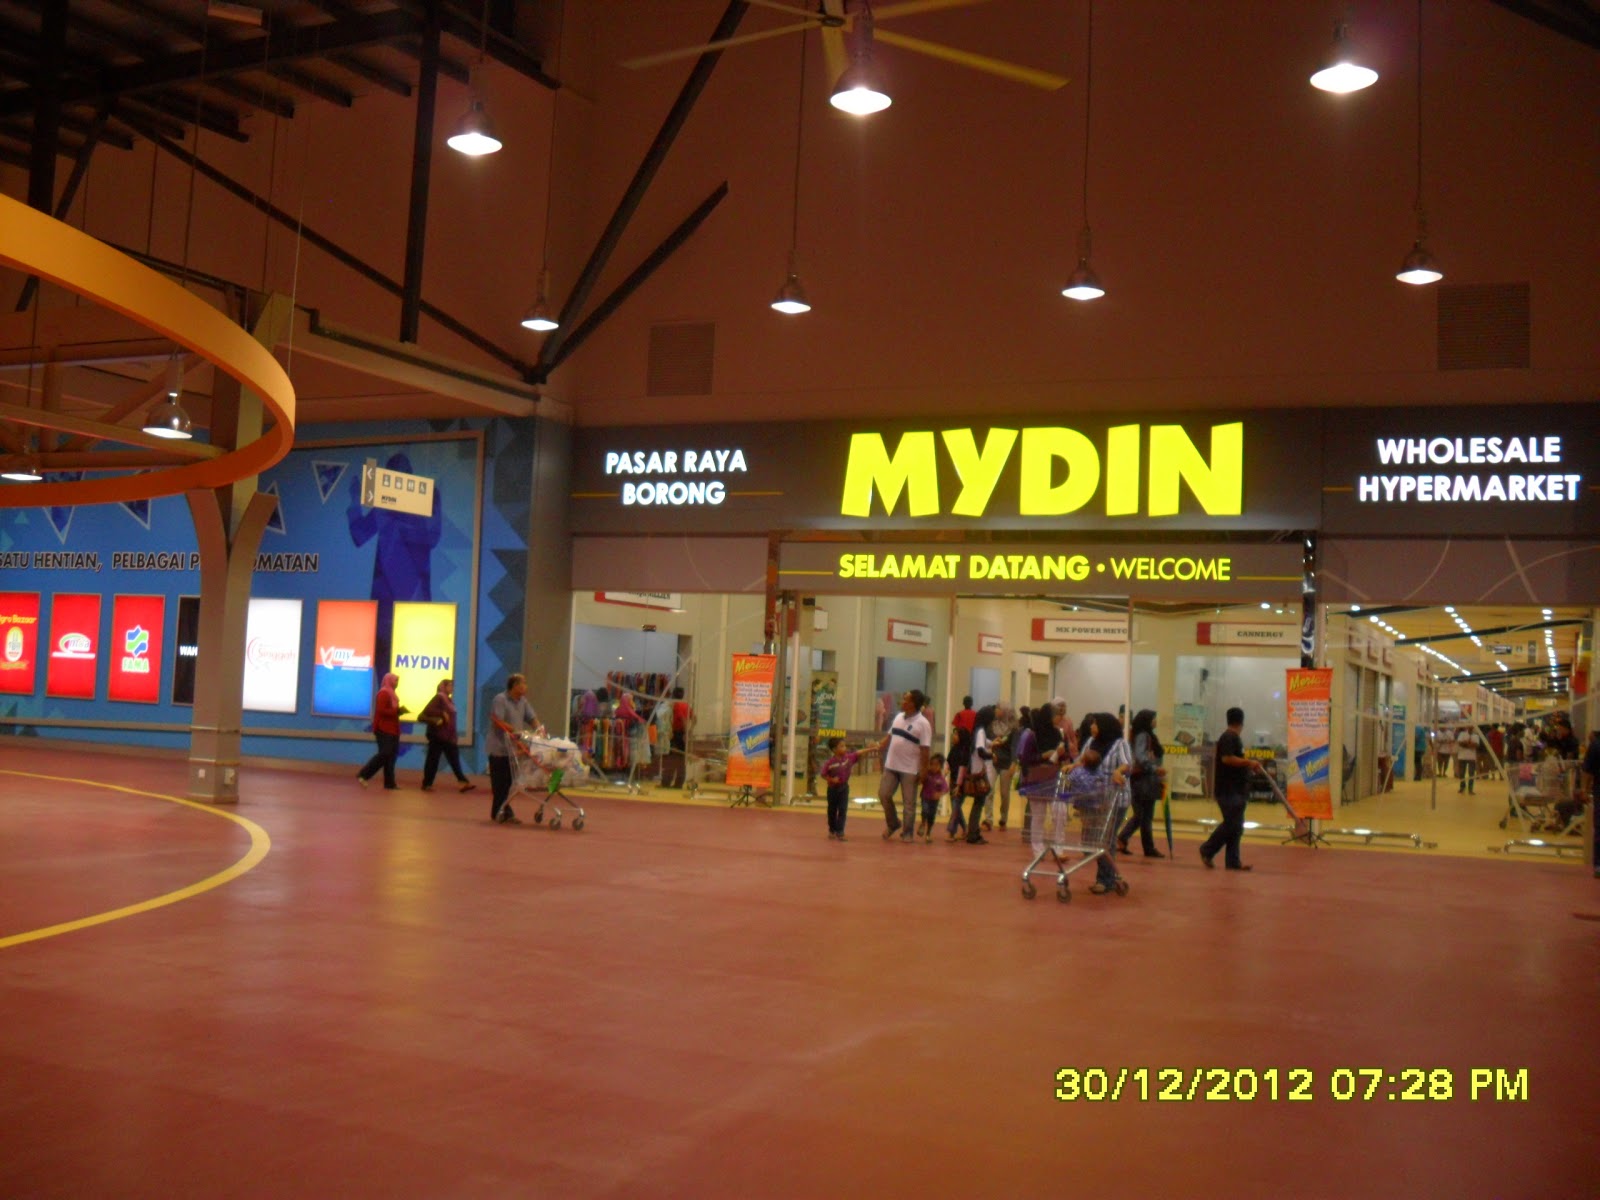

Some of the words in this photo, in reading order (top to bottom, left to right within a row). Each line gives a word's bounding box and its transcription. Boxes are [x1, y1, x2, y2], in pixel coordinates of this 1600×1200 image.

[605, 451, 677, 474] PASAR
[684, 449, 747, 472] RAYA
[1377, 437, 1561, 464] WHOLESALE
[841, 422, 1243, 517] MYDIN
[622, 482, 726, 505] BORONG
[1359, 475, 1581, 502] HYPERMARKET
[33, 551, 102, 572] HENTIAN,
[112, 552, 185, 570] PELBAGAI
[838, 554, 960, 579] SELAMAT
[969, 555, 1090, 580] DATANG
[1110, 557, 1231, 581] WELCOME
[395, 654, 450, 670] MYDIN
[818, 729, 846, 737] MYDIN
